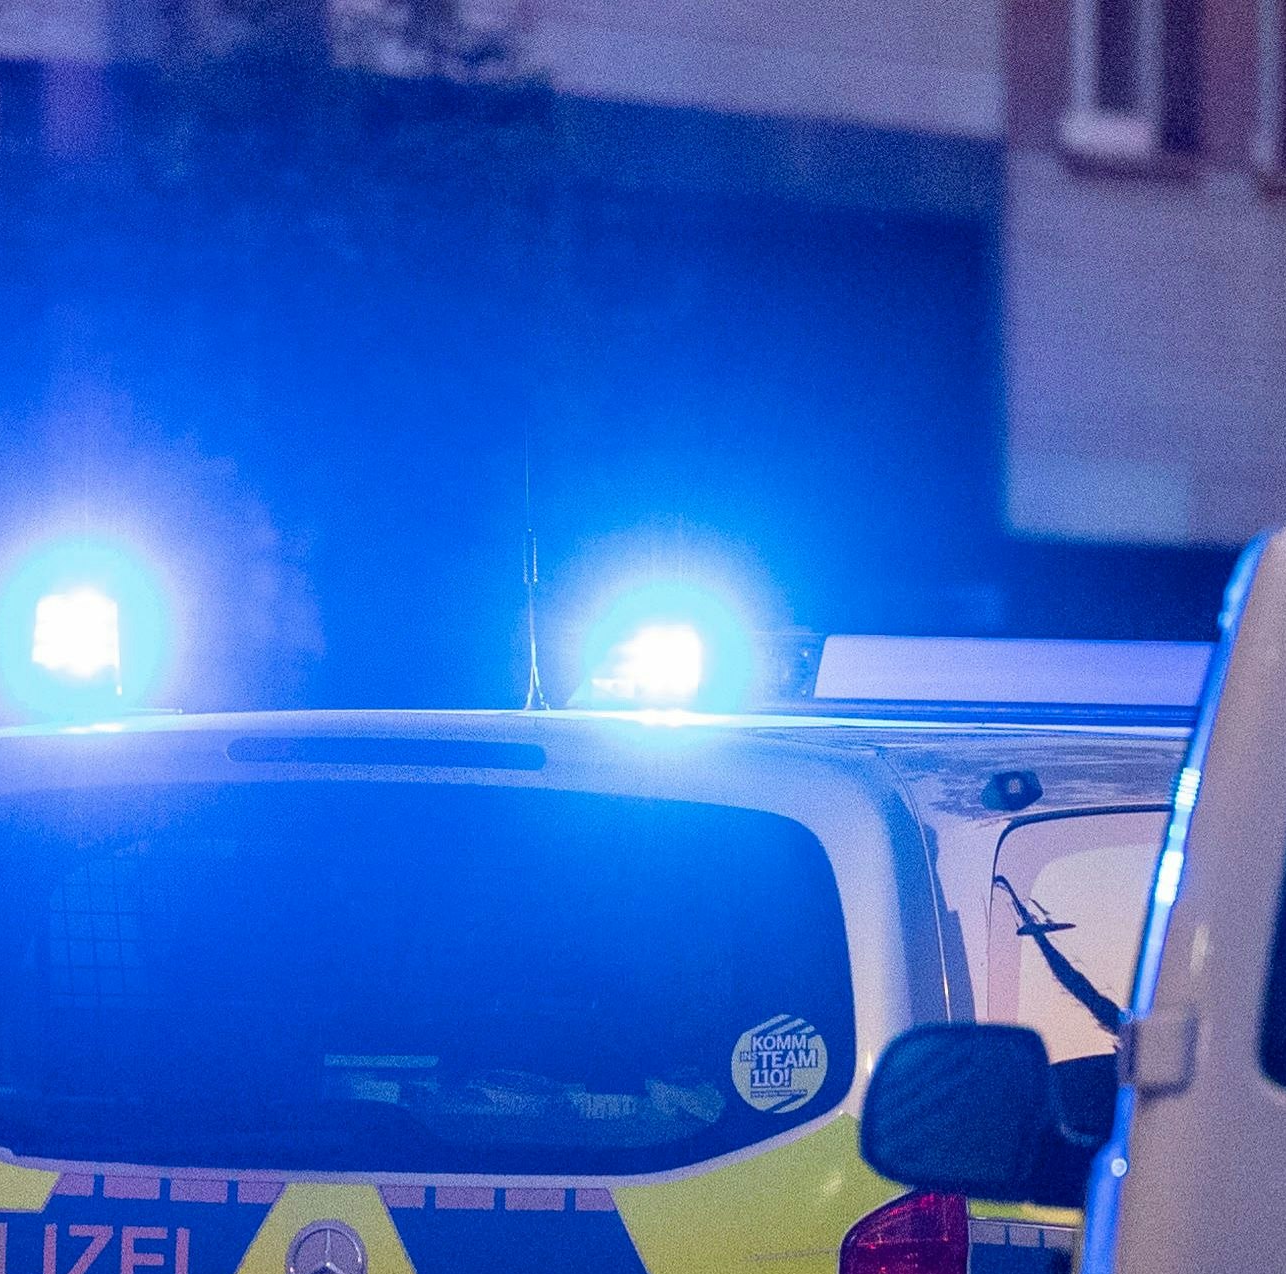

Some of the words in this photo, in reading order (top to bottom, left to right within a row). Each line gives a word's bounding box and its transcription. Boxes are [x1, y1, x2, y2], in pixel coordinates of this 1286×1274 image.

[752, 1034, 807, 1051] KOMM
[758, 1050, 818, 1069] TEAM
[752, 1068, 790, 1087] 110!
